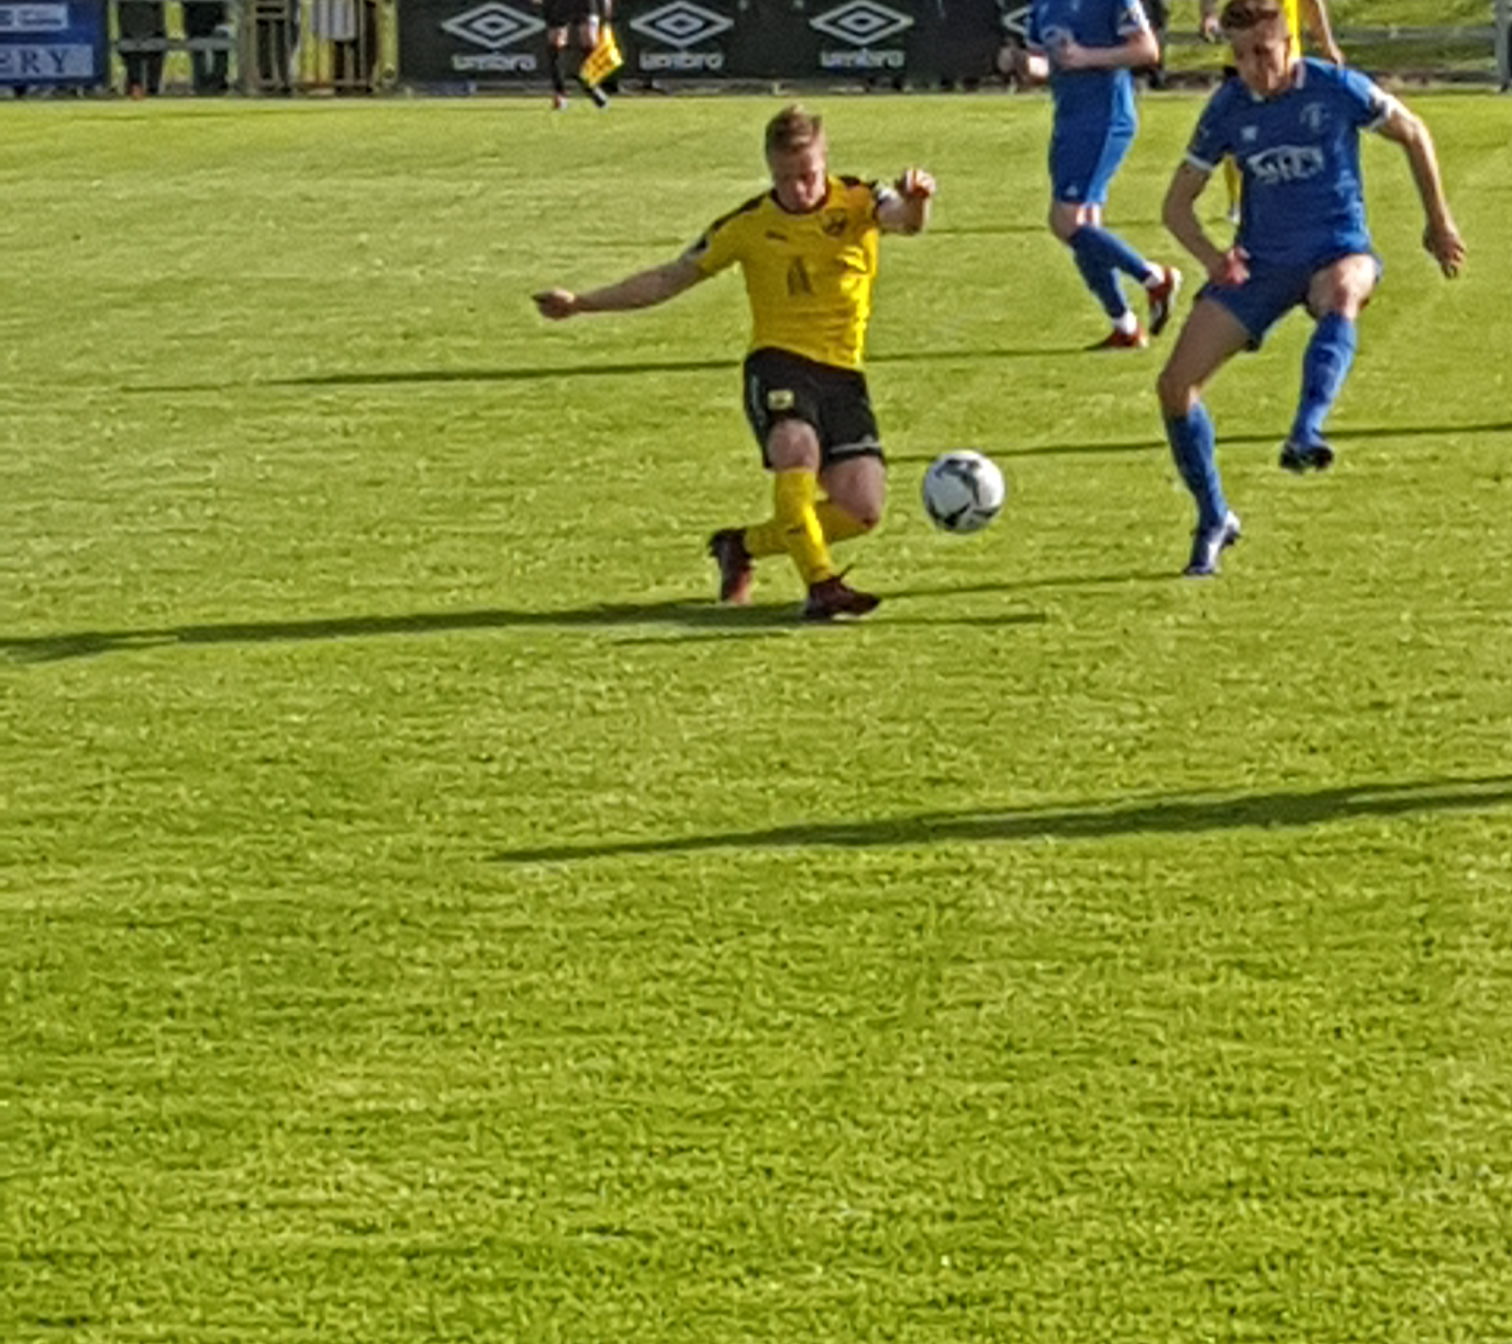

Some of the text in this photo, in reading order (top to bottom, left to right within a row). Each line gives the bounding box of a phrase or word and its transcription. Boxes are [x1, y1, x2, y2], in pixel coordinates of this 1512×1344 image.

[451, 52, 538, 71] umbro
[638, 50, 724, 70] umbro
[820, 48, 906, 68] umbro
